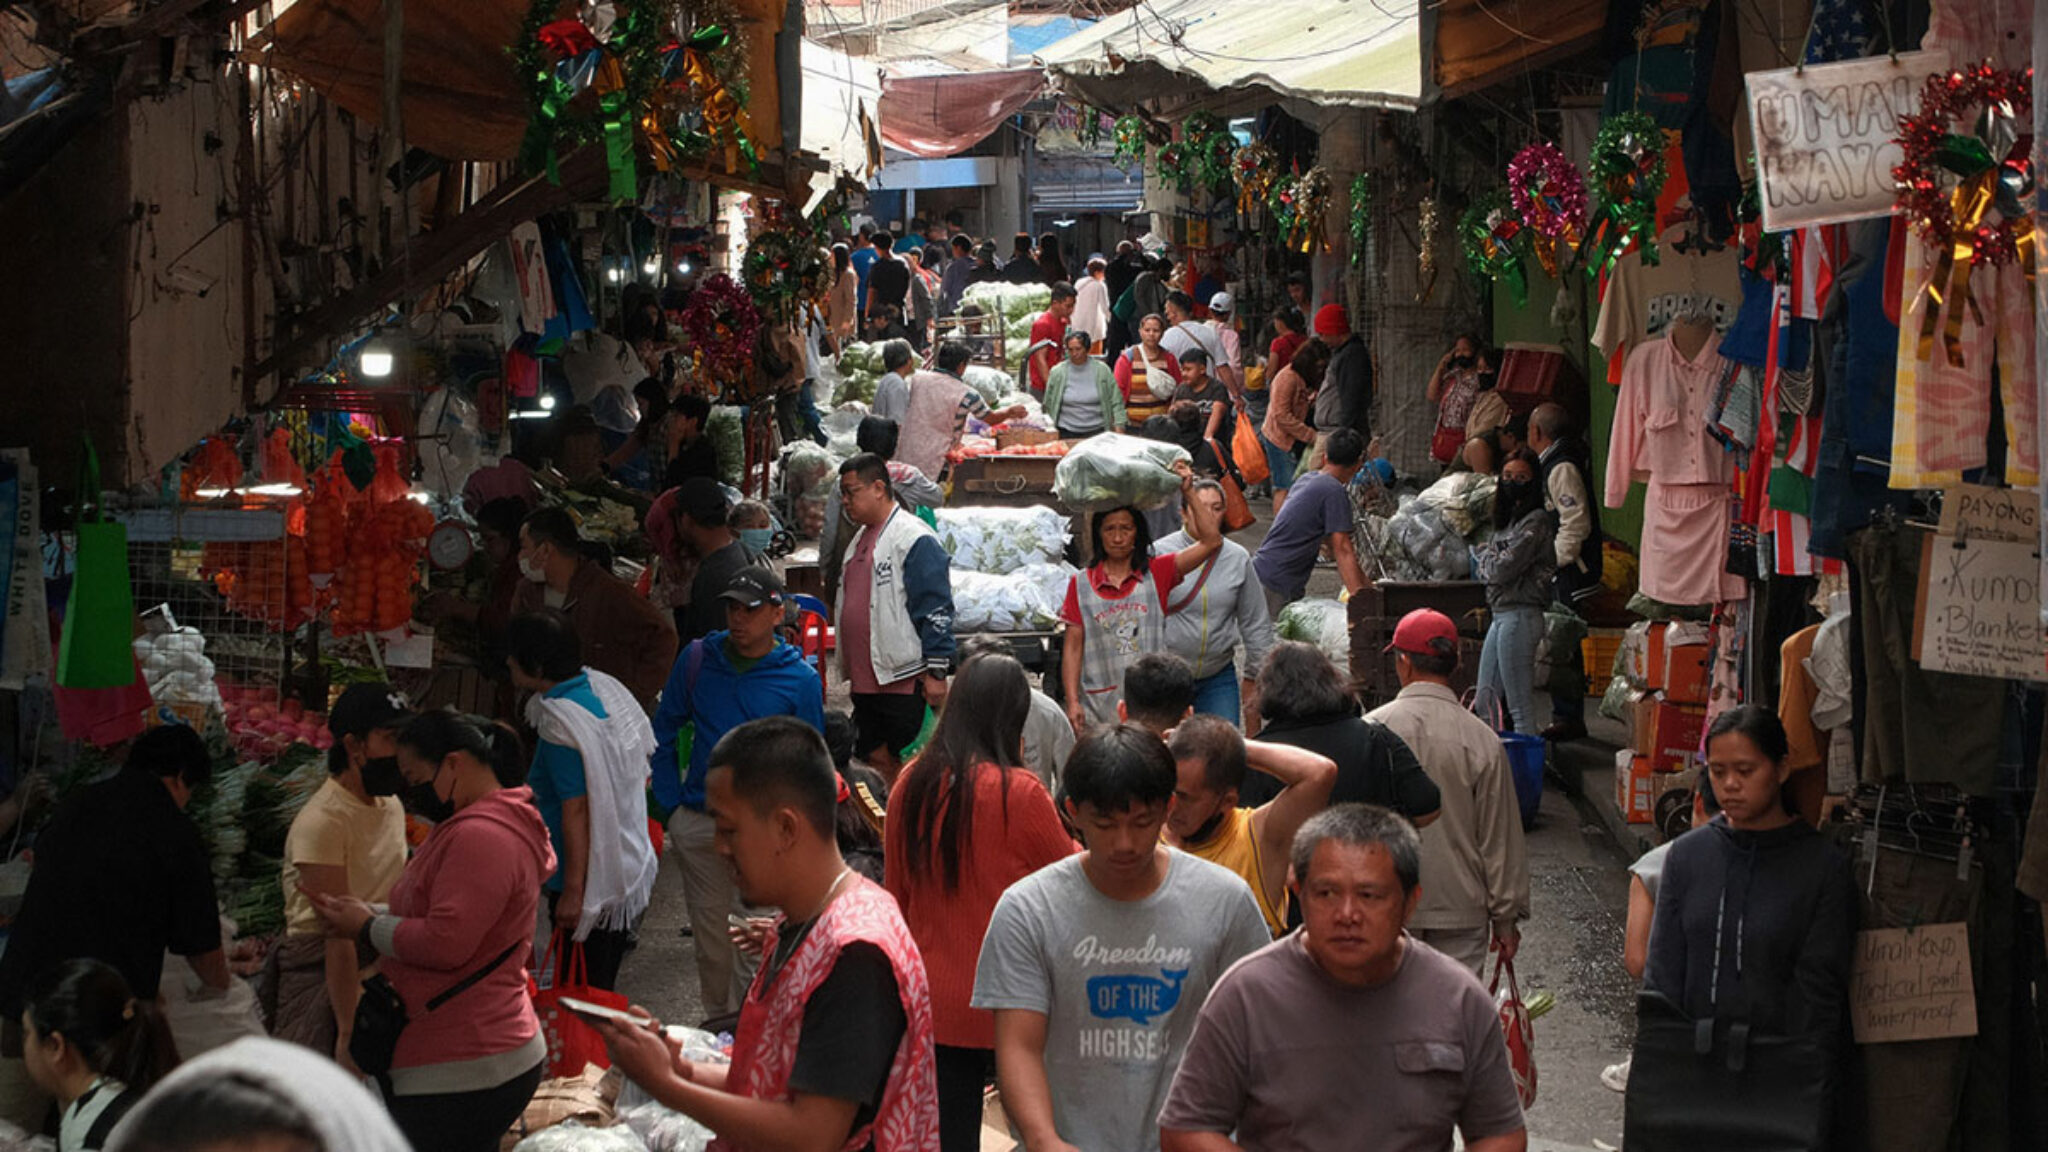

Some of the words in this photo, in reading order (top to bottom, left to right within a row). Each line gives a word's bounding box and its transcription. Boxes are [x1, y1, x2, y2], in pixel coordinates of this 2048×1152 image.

[1757, 72, 1944, 147] UMAL
[1957, 493, 2035, 527] PAYONG
[1072, 933, 1193, 968] Freedom
[1098, 984, 1122, 1012] OF
[1127, 983, 1162, 1012] THE
[1079, 1029, 1130, 1058] HIGH
